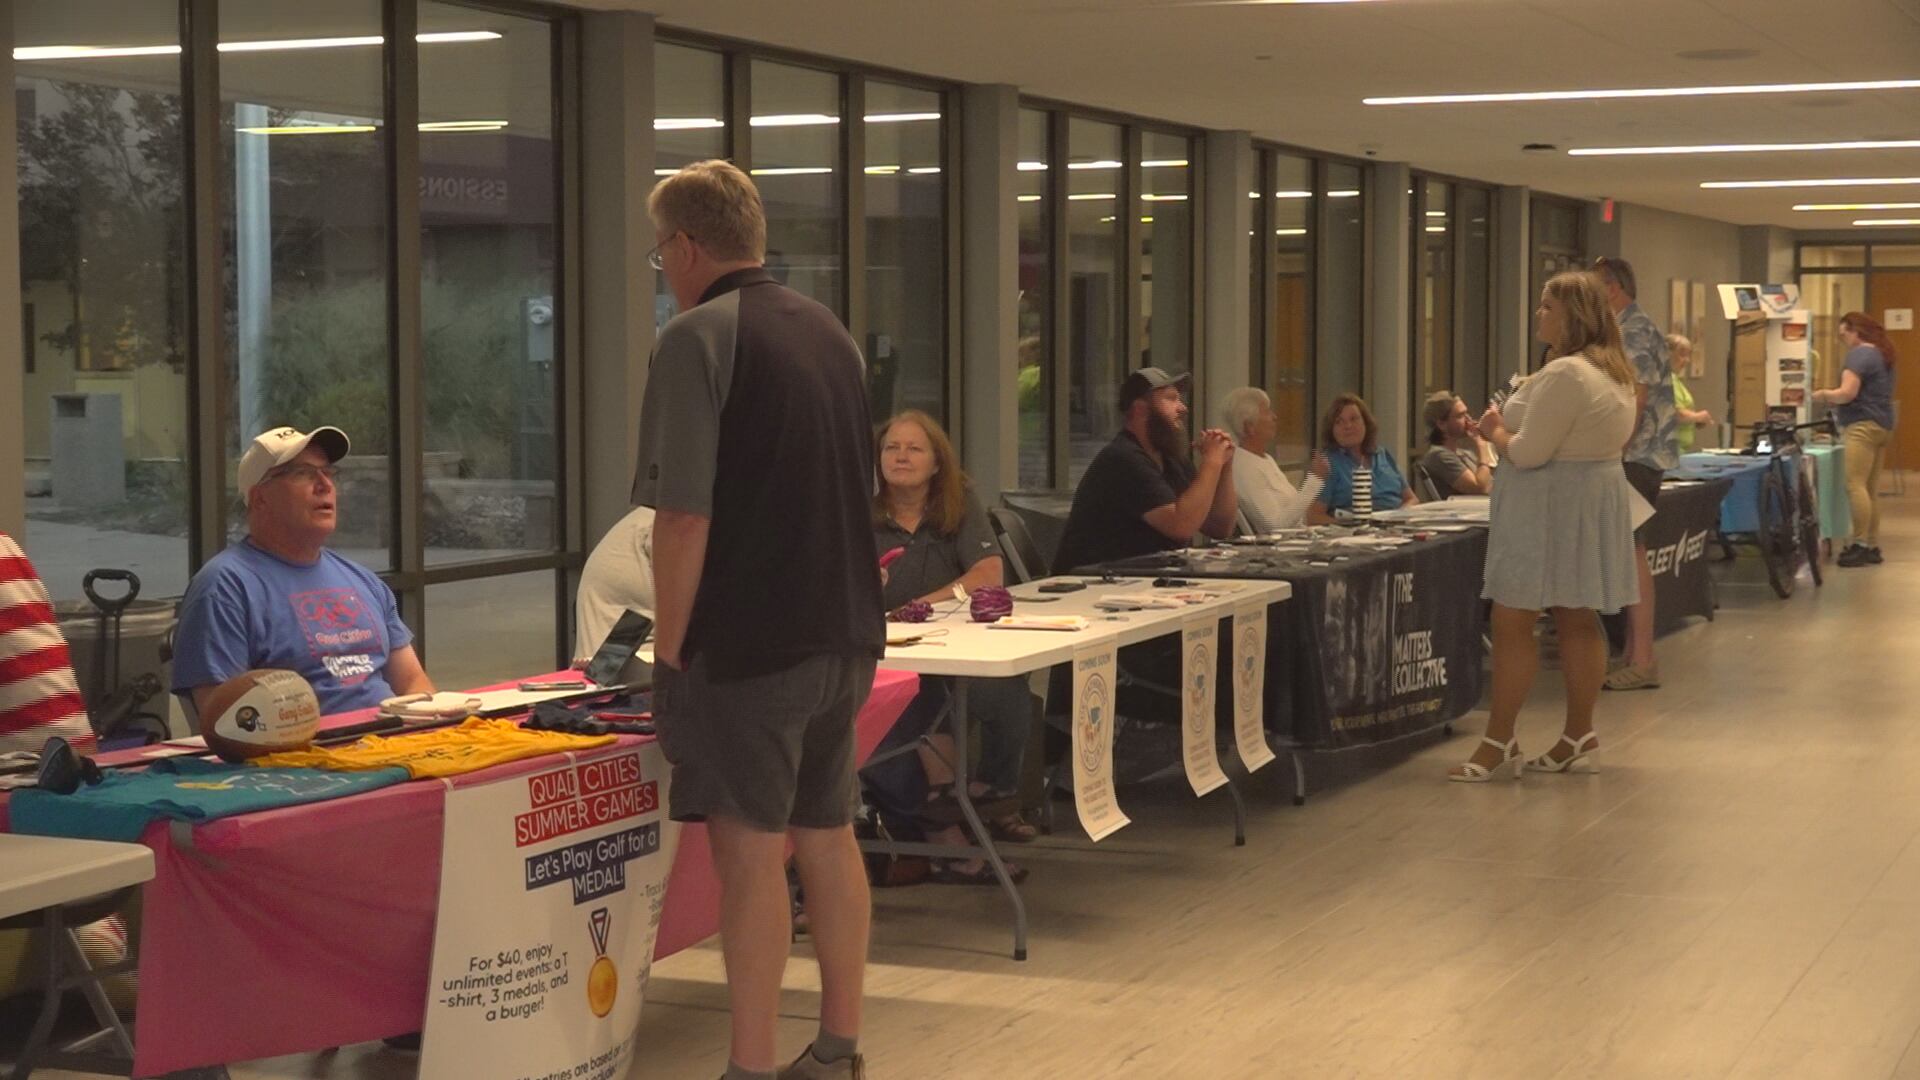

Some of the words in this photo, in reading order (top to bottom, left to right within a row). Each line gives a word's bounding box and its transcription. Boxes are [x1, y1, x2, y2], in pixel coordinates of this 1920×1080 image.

[1394, 572, 1414, 603] THE
[1394, 630, 1432, 663] MATTERS
[1393, 656, 1448, 694] COLLECTIVE
[531, 770, 577, 804] QUAD
[584, 755, 640, 790] CITIES
[517, 801, 589, 842] SUMMER
[594, 785, 654, 819] GAMES
[527, 855, 561, 883] Let's
[562, 847, 594, 873] Play
[596, 834, 627, 861] Golf
[628, 833, 646, 851] for
[647, 833, 656, 845] a
[574, 864, 624, 897] MEDAL!
[443, 973, 512, 991] unlimited
[516, 961, 553, 980] events:
[554, 959, 561, 970] a
[562, 952, 568, 966] T
[469, 956, 492, 972] For
[497, 951, 524, 967] $40,
[525, 943, 553, 963] enjoy
[439, 991, 486, 1008] -shirt,
[491, 990, 500, 1004] 3
[503, 980, 549, 1001] medals,
[550, 972, 569, 989] and
[486, 1010, 497, 1021] a
[500, 997, 545, 1020] burger!
[574, 1062, 589, 1077] are
[590, 1046, 613, 1070] based
